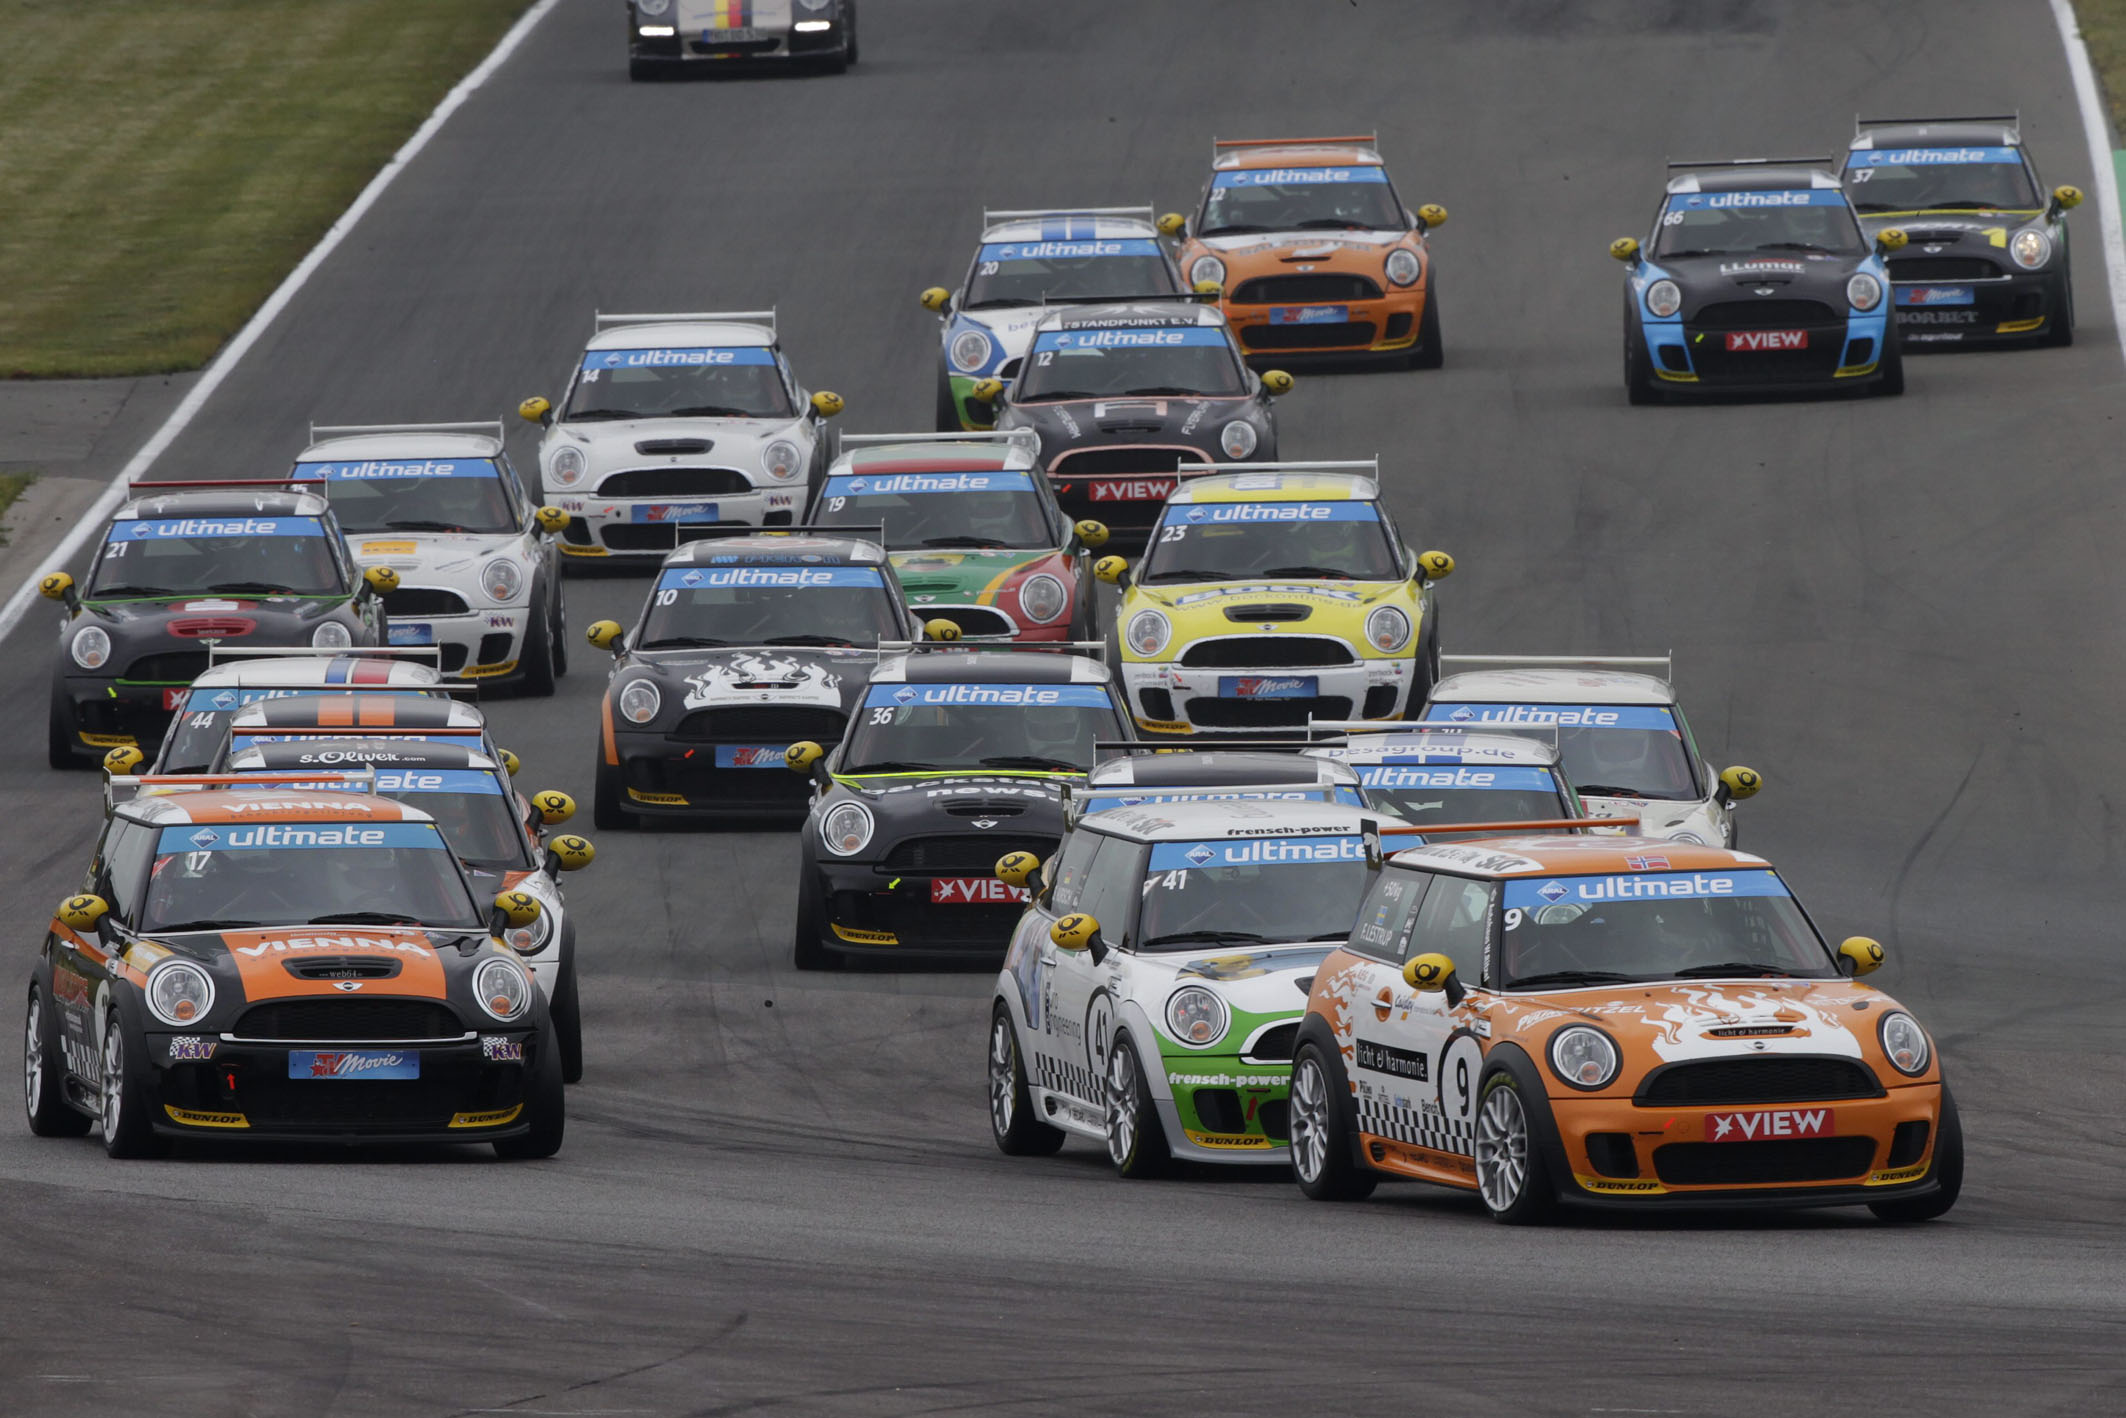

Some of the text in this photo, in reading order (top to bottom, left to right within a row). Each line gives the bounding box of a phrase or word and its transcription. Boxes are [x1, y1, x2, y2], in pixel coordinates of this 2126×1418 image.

[1889, 148, 1985, 164] ultimate
[1254, 168, 1350, 185] ultimate
[1852, 169, 1875, 184] 37
[1709, 191, 1810, 207] ultimate
[1663, 211, 1684, 226] 66
[1022, 241, 1122, 258] ultimate
[979, 262, 998, 276] 20
[1078, 331, 1184, 347] ultimate
[1744, 332, 1803, 350] VIEW
[628, 350, 735, 366] ultimate
[1037, 351, 1053, 367] 12
[341, 461, 455, 478] ultimate
[874, 473, 990, 492] ultimate
[1108, 481, 1170, 500] VIEW
[827, 496, 846, 513] 19
[1213, 503, 1332, 522] ultimate
[158, 519, 276, 538] ultimate
[1160, 525, 1189, 543] 23
[106, 541, 128, 559] 21
[709, 568, 833, 585] ultimate
[655, 590, 678, 607] 10
[924, 686, 1059, 704] ultimate
[1252, 678, 1305, 695] Movie
[190, 712, 214, 729] 44
[869, 707, 894, 726] 36
[1481, 706, 1619, 725] ultimate
[220, 801, 372, 813] VIENNA
[228, 825, 385, 847] ultimate
[1227, 824, 1351, 837] frensch-power
[188, 851, 212, 871] 17
[1162, 869, 1188, 891] 41
[1578, 874, 1734, 900] ultimate
[1504, 908, 1523, 932] 9
[235, 936, 432, 958] VIENNA
[174, 1043, 218, 1060] KW
[491, 1044, 523, 1061] KW
[1357, 1041, 1375, 1068] licht
[333, 1053, 404, 1075] Movie
[1168, 1071, 1290, 1087] frensch-power
[1456, 1056, 1470, 1118] 9
[181, 1111, 242, 1125] DUNLOP
[1736, 1109, 1827, 1141] VIEW
[1203, 1136, 1265, 1146] DUNLOP
[1880, 1167, 1926, 1182] DUNLOP
[1594, 1181, 1659, 1192] DUNLOP
